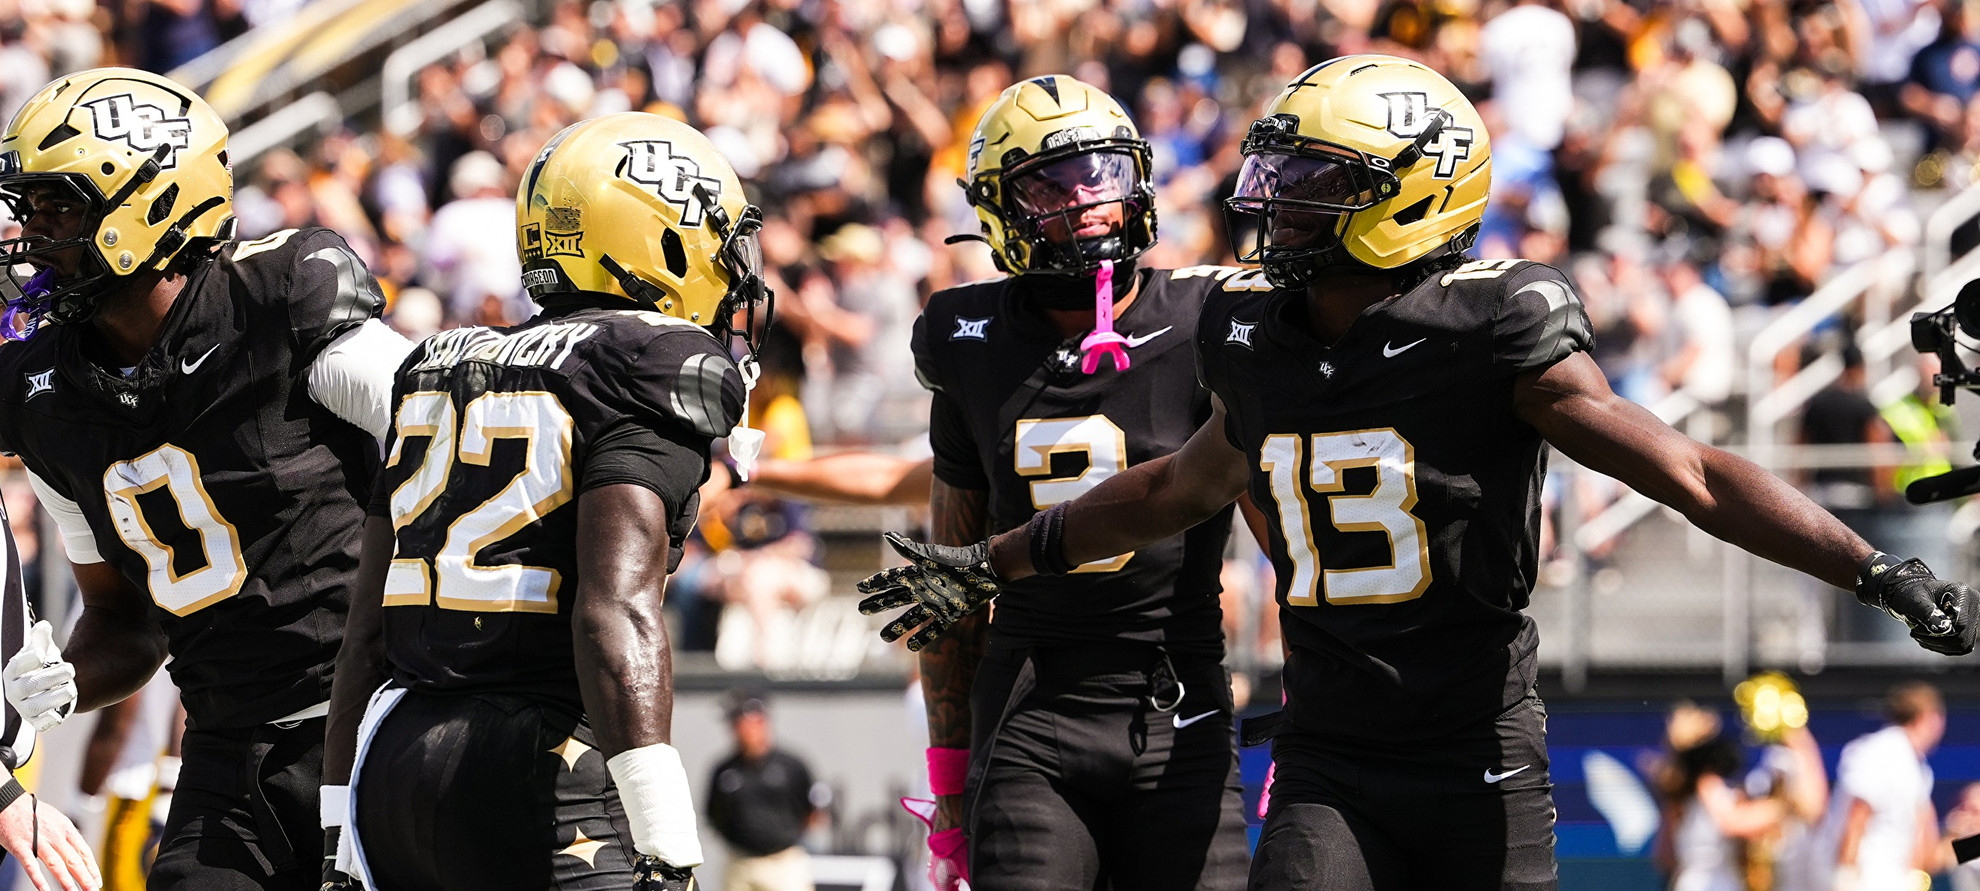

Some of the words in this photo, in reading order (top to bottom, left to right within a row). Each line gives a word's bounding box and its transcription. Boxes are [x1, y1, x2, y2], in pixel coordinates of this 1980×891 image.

[81, 93, 191, 169] UCF
[617, 140, 721, 227] UCF
[103, 442, 248, 617] 0
[382, 391, 574, 614] 22
[1014, 414, 1135, 574] 3
[1259, 427, 1433, 606] 13
